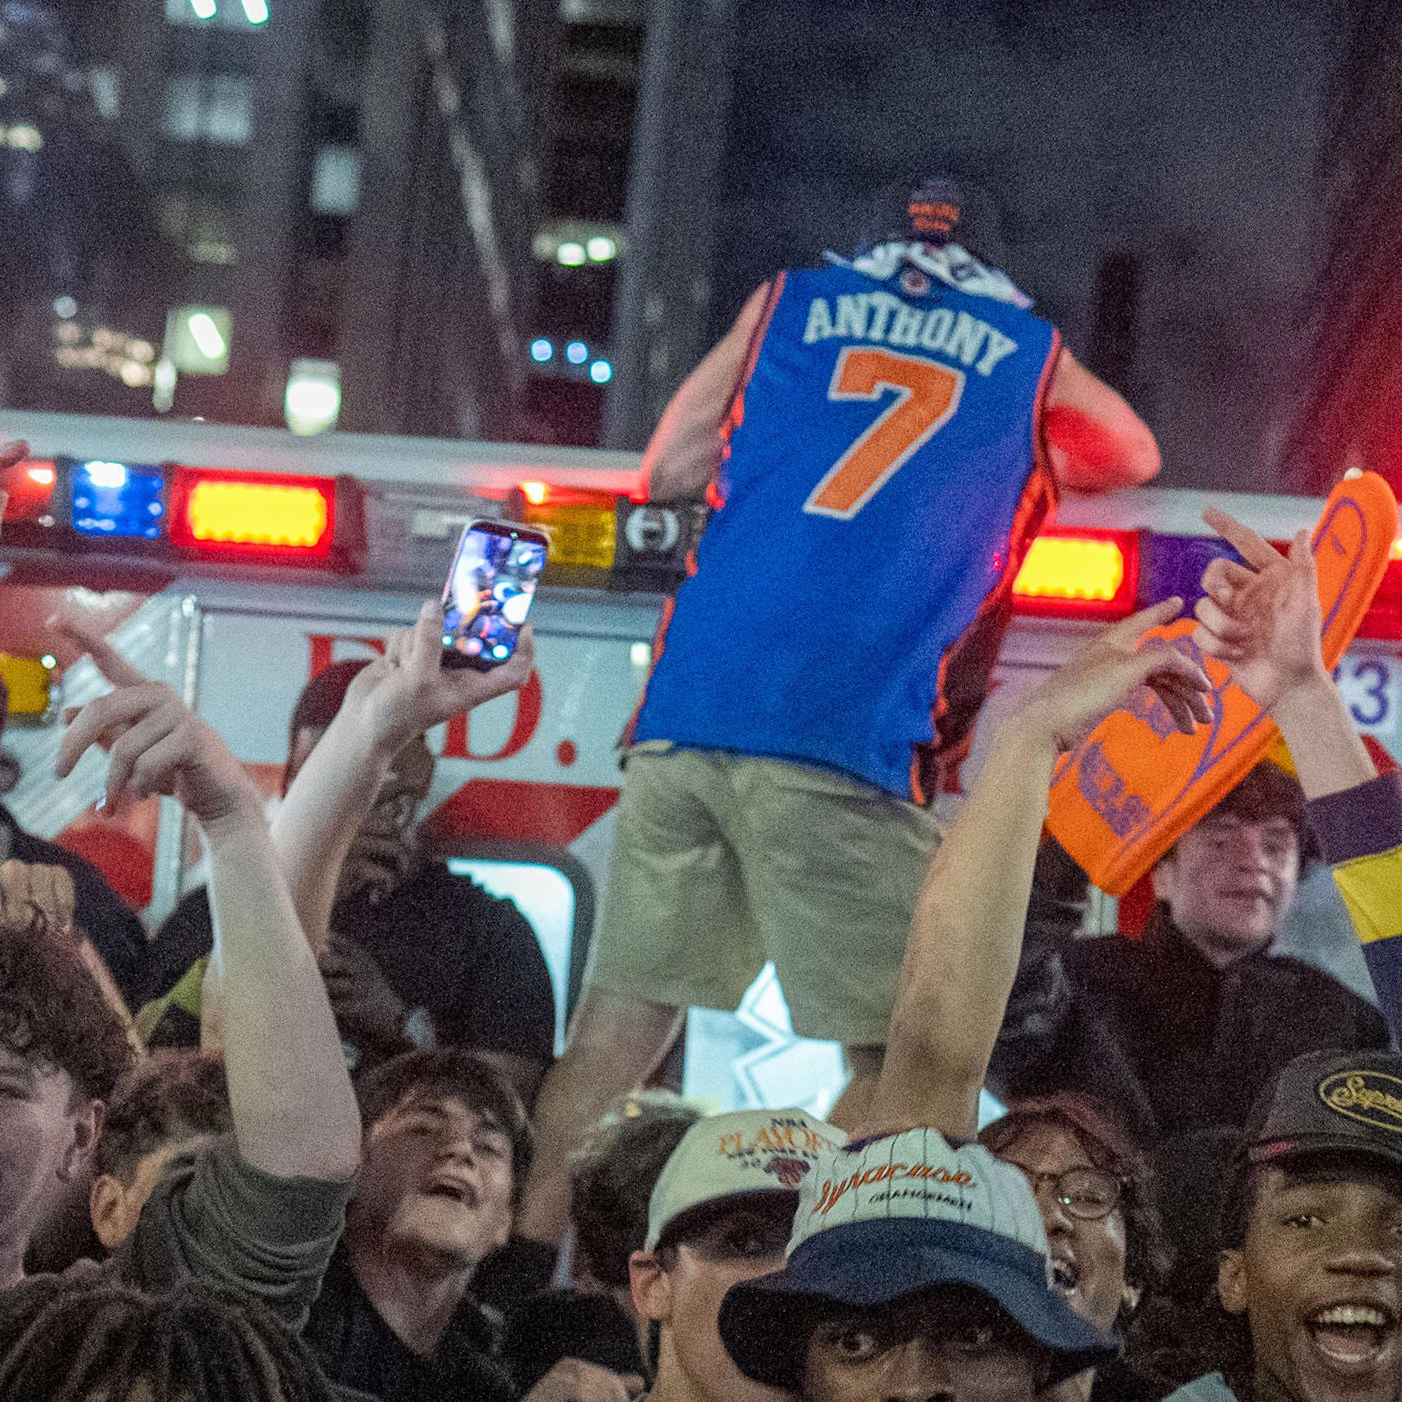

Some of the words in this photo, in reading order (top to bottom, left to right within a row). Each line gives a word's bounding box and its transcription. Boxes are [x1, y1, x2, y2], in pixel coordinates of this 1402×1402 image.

[803, 291, 1018, 376] ANTHONY
[803, 345, 966, 521] 7
[812, 1163, 973, 1215] Syracuse
